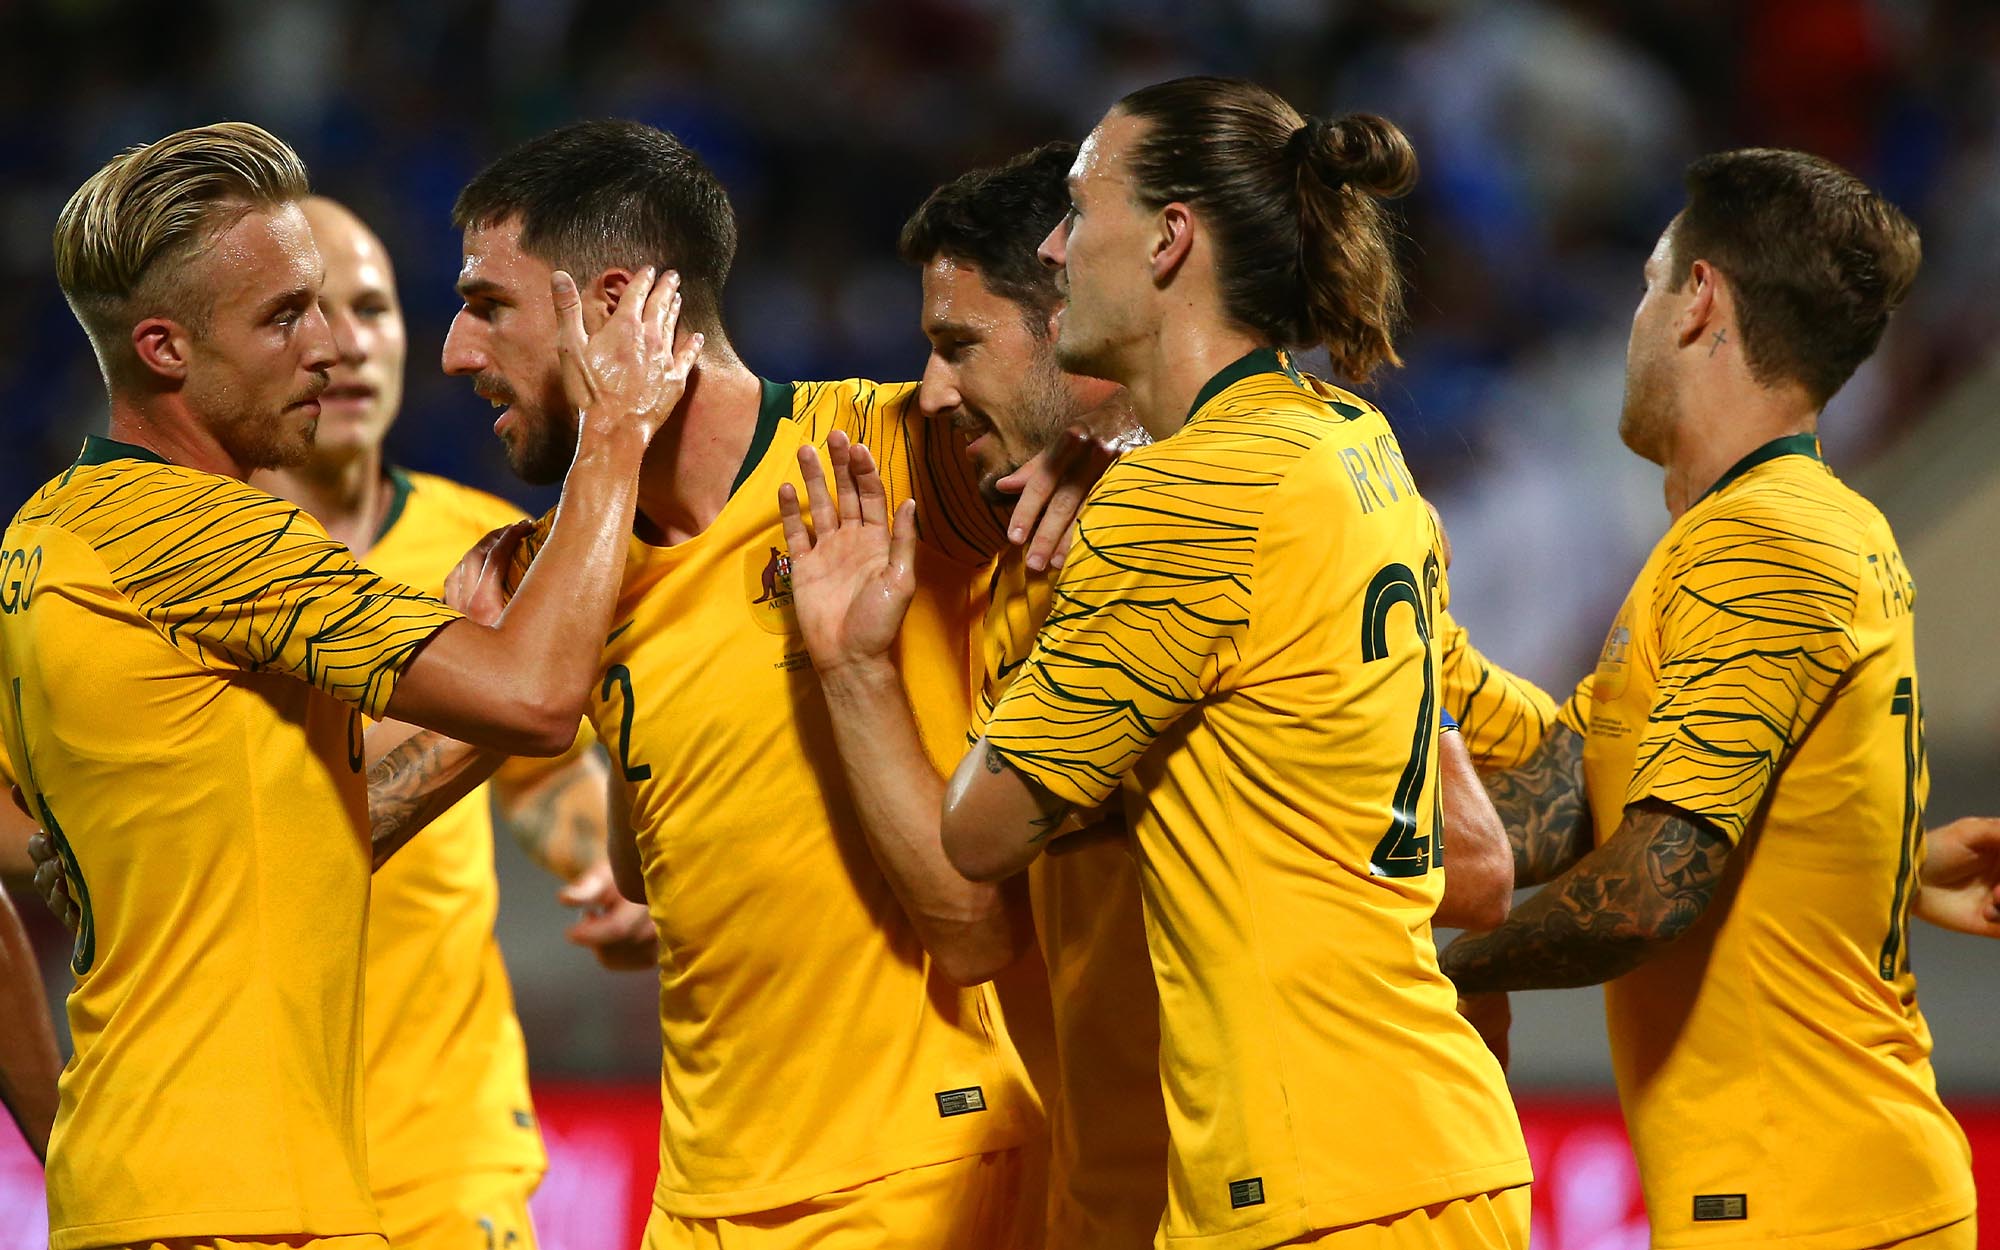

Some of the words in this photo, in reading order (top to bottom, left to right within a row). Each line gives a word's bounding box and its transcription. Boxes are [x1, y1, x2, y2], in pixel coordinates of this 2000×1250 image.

[0, 545, 42, 614] GO
[602, 663, 651, 781] 2
[1880, 677, 1925, 982] 1
